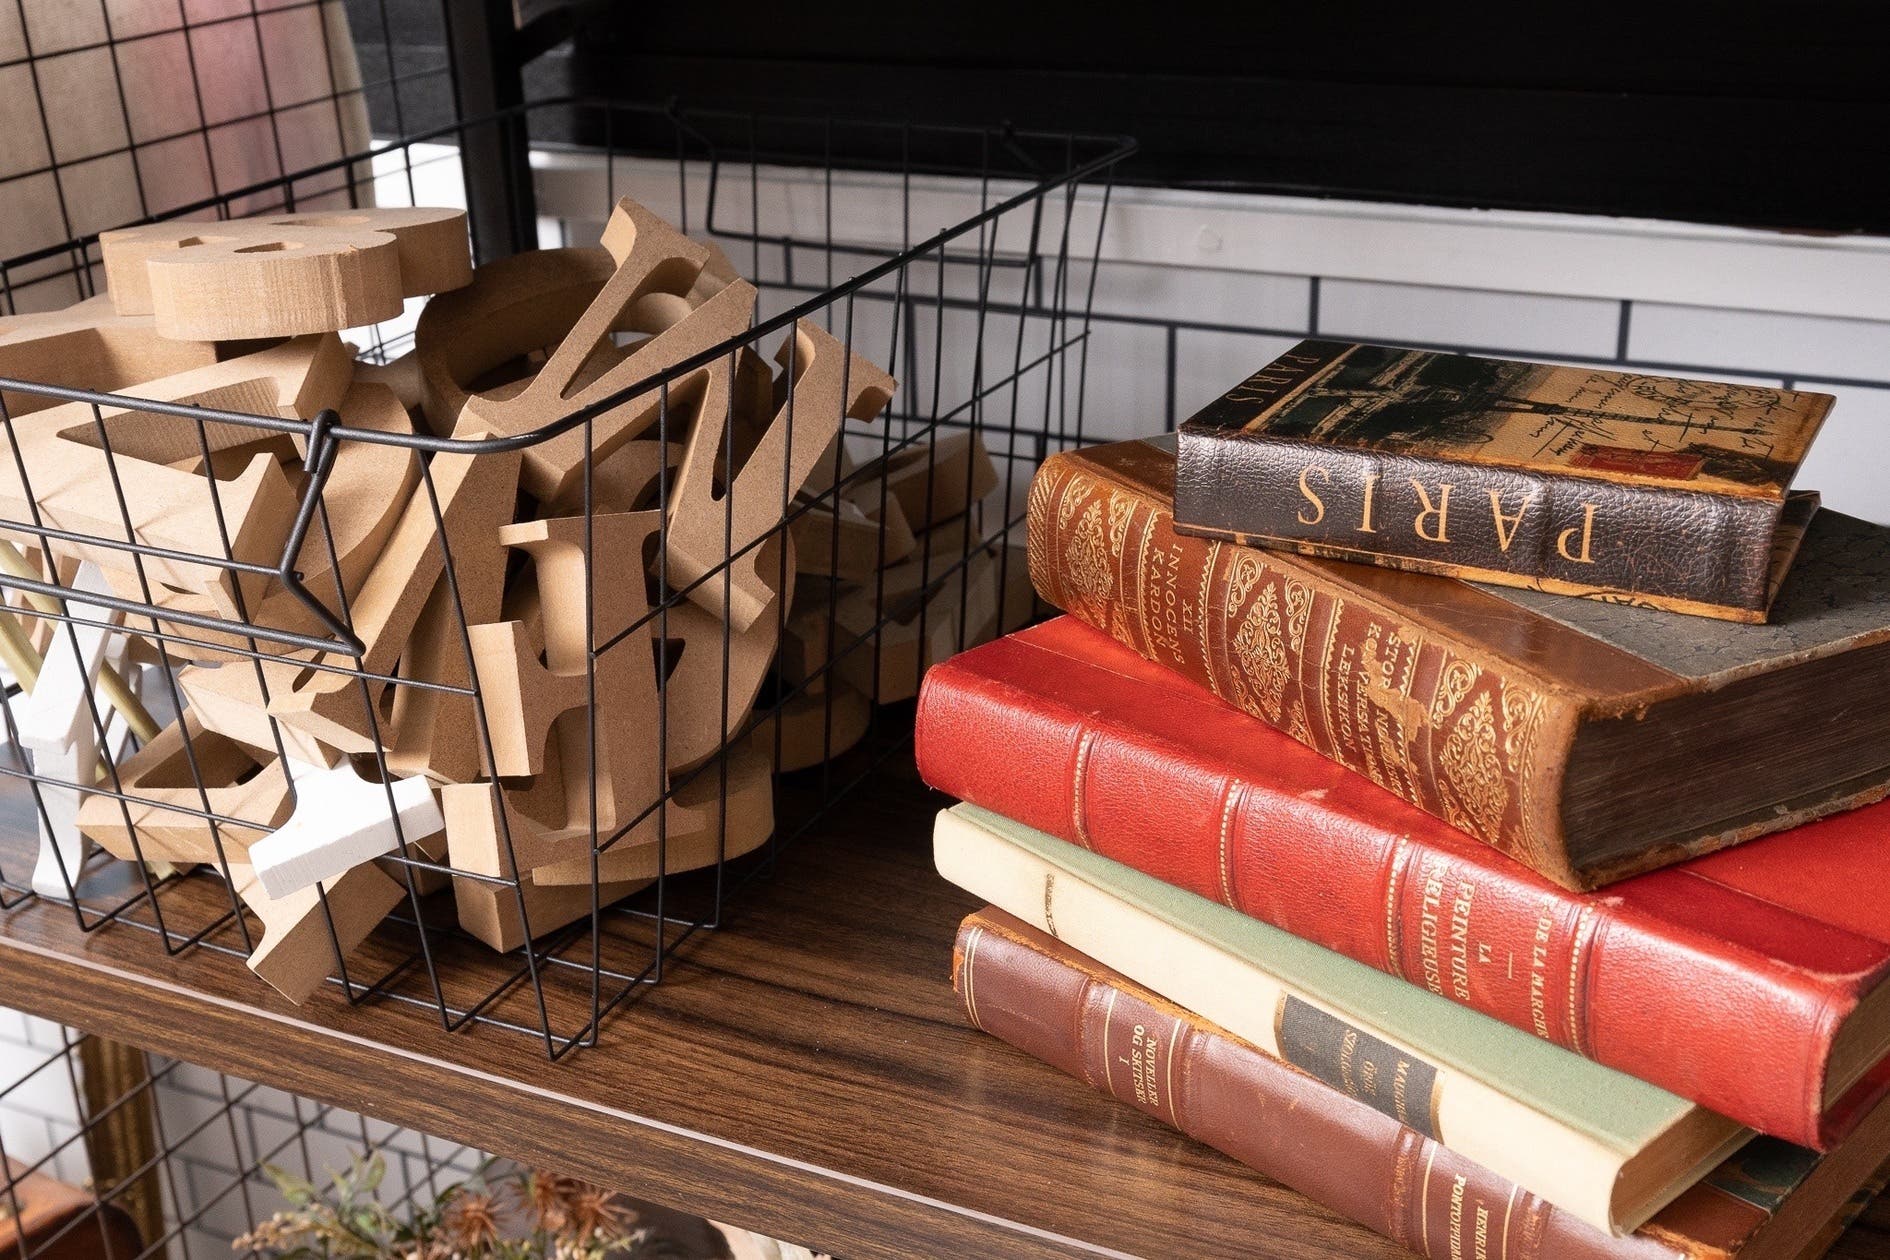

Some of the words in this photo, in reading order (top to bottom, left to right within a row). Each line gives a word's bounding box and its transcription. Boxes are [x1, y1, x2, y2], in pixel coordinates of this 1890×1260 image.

[1225, 353, 1320, 404] PARIS
[1297, 464, 1600, 564] PARIS
[1151, 547, 1167, 648] KARDON
[1166, 544, 1185, 664] INNOCENS
[1182, 599, 1194, 634] XII
[1338, 644, 1357, 752] LEKSIKON
[1376, 632, 1401, 706] STOR
[1421, 861, 1448, 996] RELIGIEUSE
[1452, 881, 1476, 1000] PEINTURE
[1478, 941, 1492, 964] LA
[1533, 945, 1547, 968] LA
[1535, 915, 1552, 942] DE
[1132, 1024, 1145, 1047] OG
[1531, 972, 1549, 1038] MARCHE
[1131, 1048, 1147, 1104] SKITSER
[1145, 1037, 1159, 1106] NOVELLER
